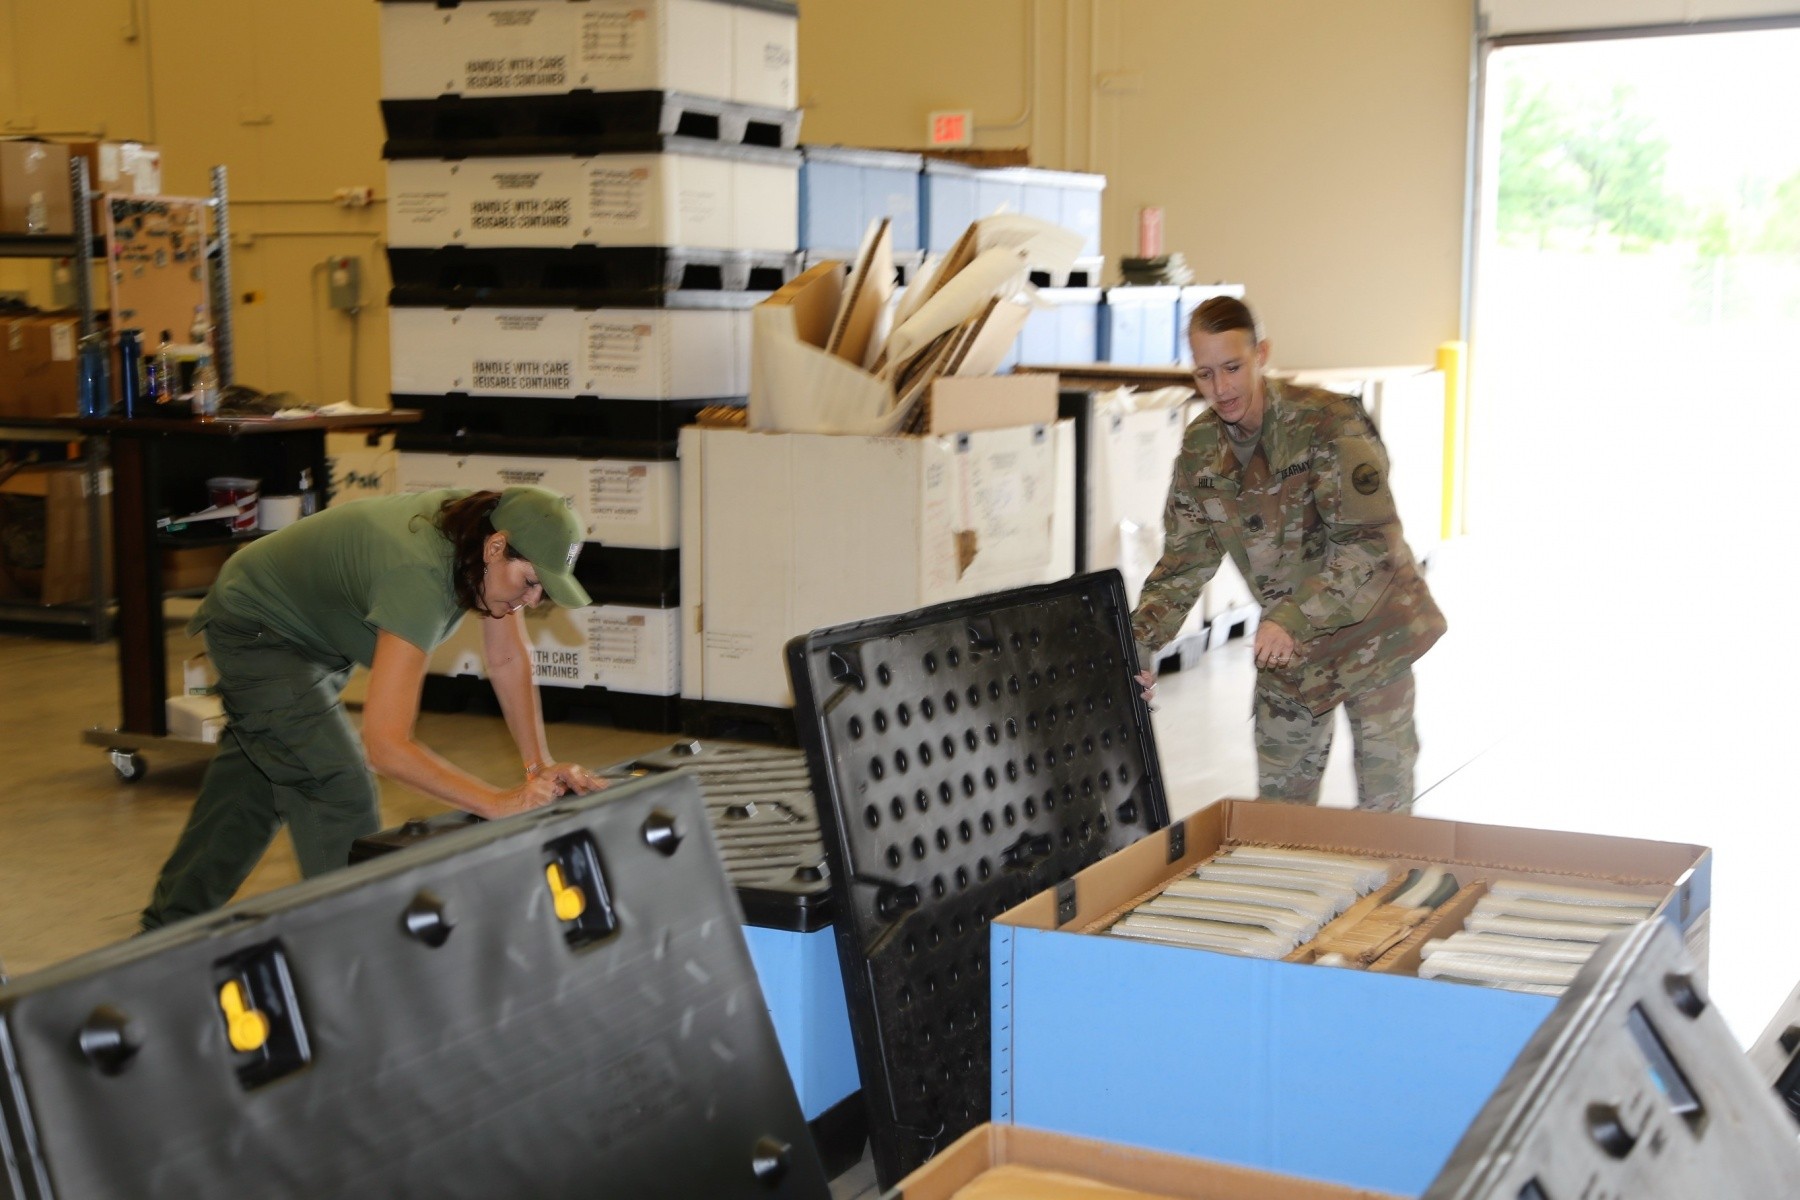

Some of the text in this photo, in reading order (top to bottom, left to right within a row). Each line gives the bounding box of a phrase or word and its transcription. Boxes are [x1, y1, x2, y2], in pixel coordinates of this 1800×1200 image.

[510, 57, 535, 71] WITH
[538, 55, 565, 71] CARE
[515, 200, 539, 213] WITH
[542, 198, 570, 214] CARE
[472, 362, 569, 376] HANDLE WITH CARE
[473, 377, 570, 389] REUSABLE CONTAINER
[552, 651, 579, 665] CARE
